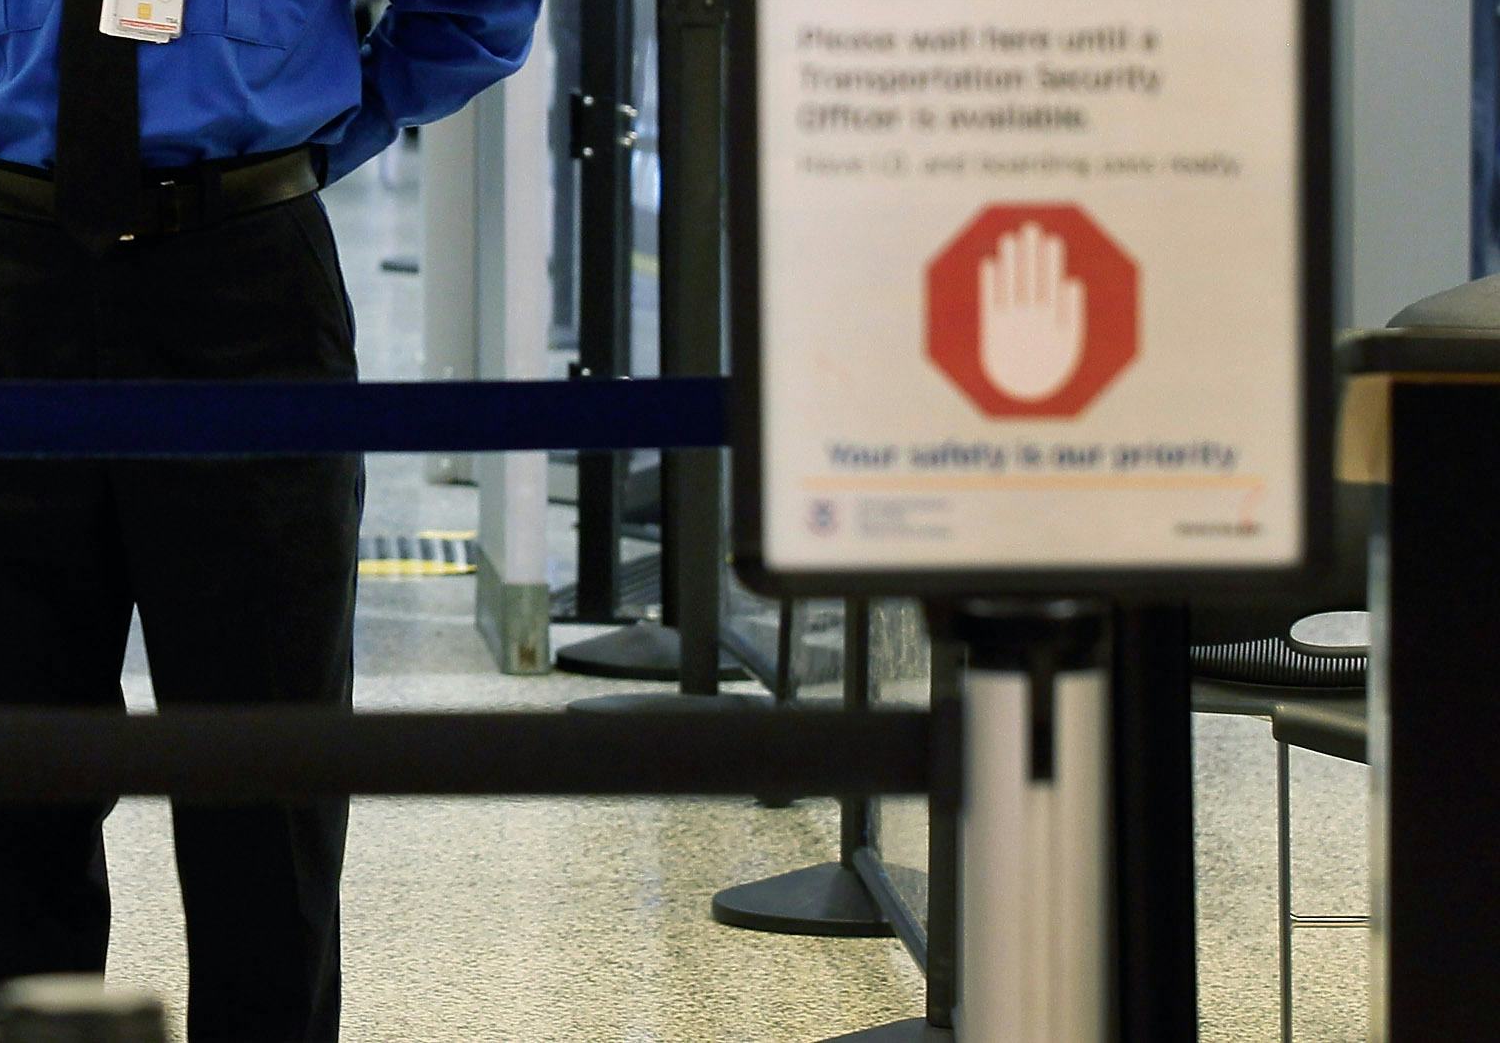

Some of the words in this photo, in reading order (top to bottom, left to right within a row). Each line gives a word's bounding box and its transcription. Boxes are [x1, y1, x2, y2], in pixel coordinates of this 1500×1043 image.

[799, 25, 895, 54] Please
[909, 25, 971, 54] wait
[982, 25, 1051, 54] here
[1061, 24, 1130, 54] until
[1140, 30, 1160, 54] a
[800, 64, 1025, 97] Transportation
[1037, 63, 1163, 98] Security
[799, 102, 898, 131] Officer
[914, 105, 936, 131] is
[828, 441, 895, 469] Your
[908, 440, 1006, 473] safety
[1017, 441, 1043, 469] is
[1051, 444, 1103, 470] our
[1111, 441, 1239, 474] priority
